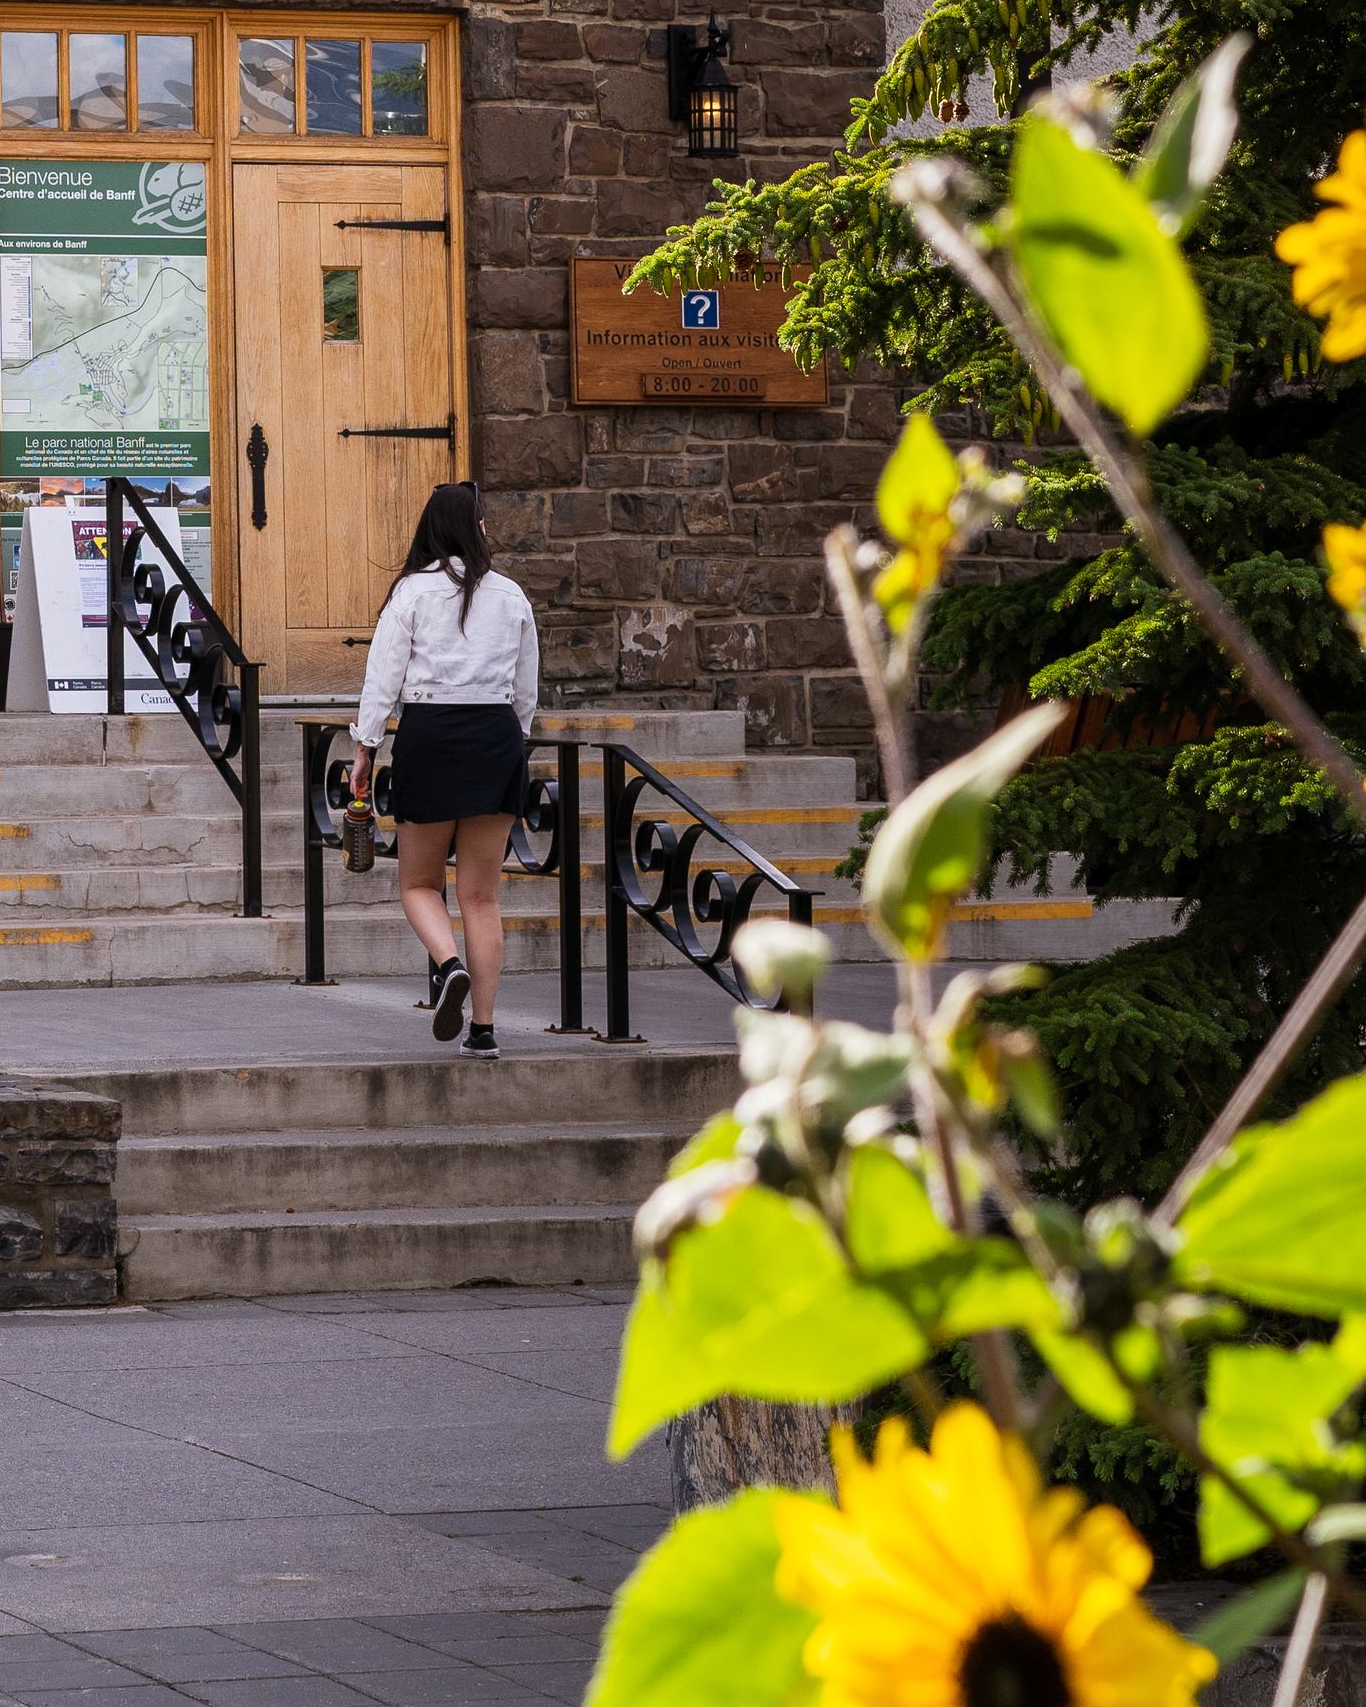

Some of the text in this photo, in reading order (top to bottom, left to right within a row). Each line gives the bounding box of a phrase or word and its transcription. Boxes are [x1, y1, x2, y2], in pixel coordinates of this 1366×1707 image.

[37, 189, 87, 200] d'accueil
[89, 190, 104, 200] de
[106, 190, 136, 201] Banff
[15, 240, 51, 249] environs
[52, 240, 63, 249] de
[65, 240, 88, 249] Banff
[586, 330, 692, 347] Information
[698, 334, 730, 347] aux
[661, 357, 692, 370] Open
[703, 357, 742, 369] Ouvert
[653, 376, 692, 393] 8:00
[710, 377, 759, 393] 20:00
[25, 436, 40, 448] Le
[42, 438, 68, 450] parc
[70, 436, 113, 449] national
[116, 436, 145, 448] Banff
[140, 692, 174, 705] Cana
